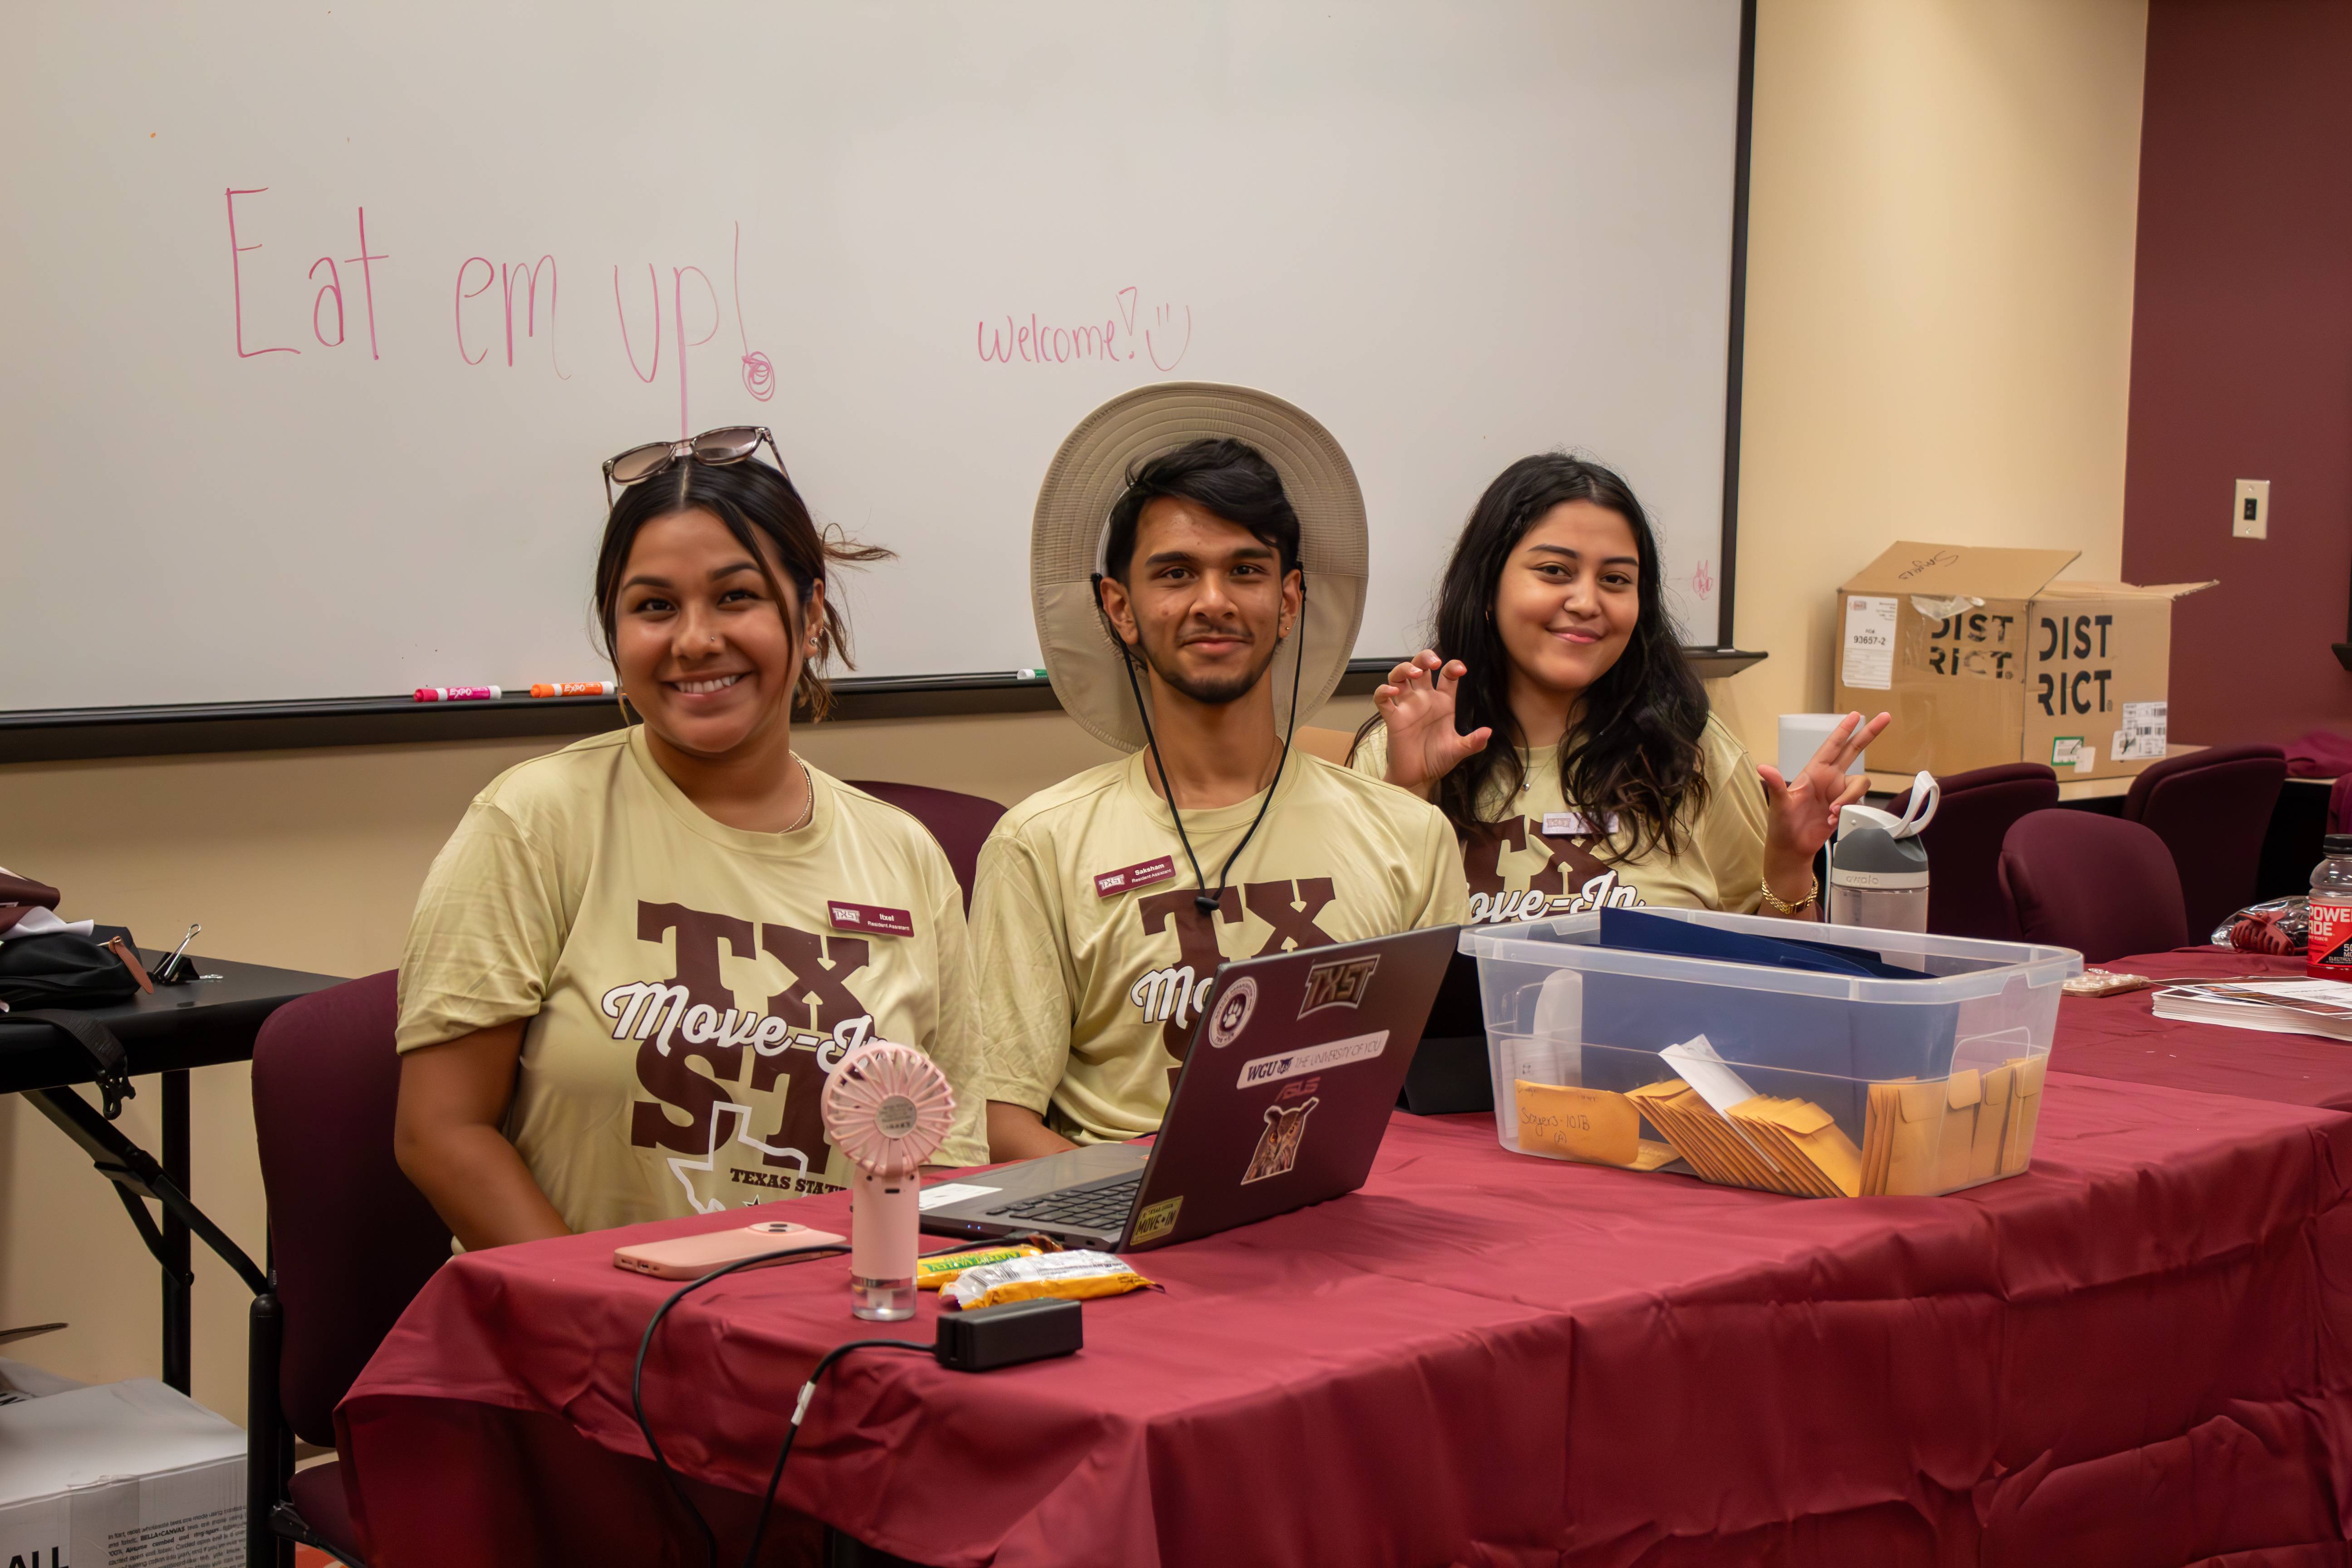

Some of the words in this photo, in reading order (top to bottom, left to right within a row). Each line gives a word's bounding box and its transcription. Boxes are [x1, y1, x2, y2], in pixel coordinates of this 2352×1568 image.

[225, 186, 389, 361] Eat
[454, 254, 573, 380] em
[1853, 635, 1886, 646] 93657-2
[2039, 615, 2112, 662] DIST
[449, 687, 473, 699] EXPO
[564, 683, 586, 692] EXPO
[1132, 874, 1152, 883] Resident
[1152, 868, 1172, 878] Assistant
[1134, 863, 1165, 876] Saksham
[1098, 873, 1125, 891] TXST
[831, 907, 861, 924] TXST
[879, 913, 895, 921] Itxel
[867, 921, 888, 929] Resident
[637, 898, 876, 1034] TX
[1300, 956, 1377, 1014] TXST
[1247, 1060, 1277, 1082] WGU
[1310, 1045, 1351, 1067] UNIVERSITY
[1351, 1044, 1363, 1056] OF
[1364, 1037, 1382, 1054] YOU
[730, 1168, 791, 1190] TEXAS
